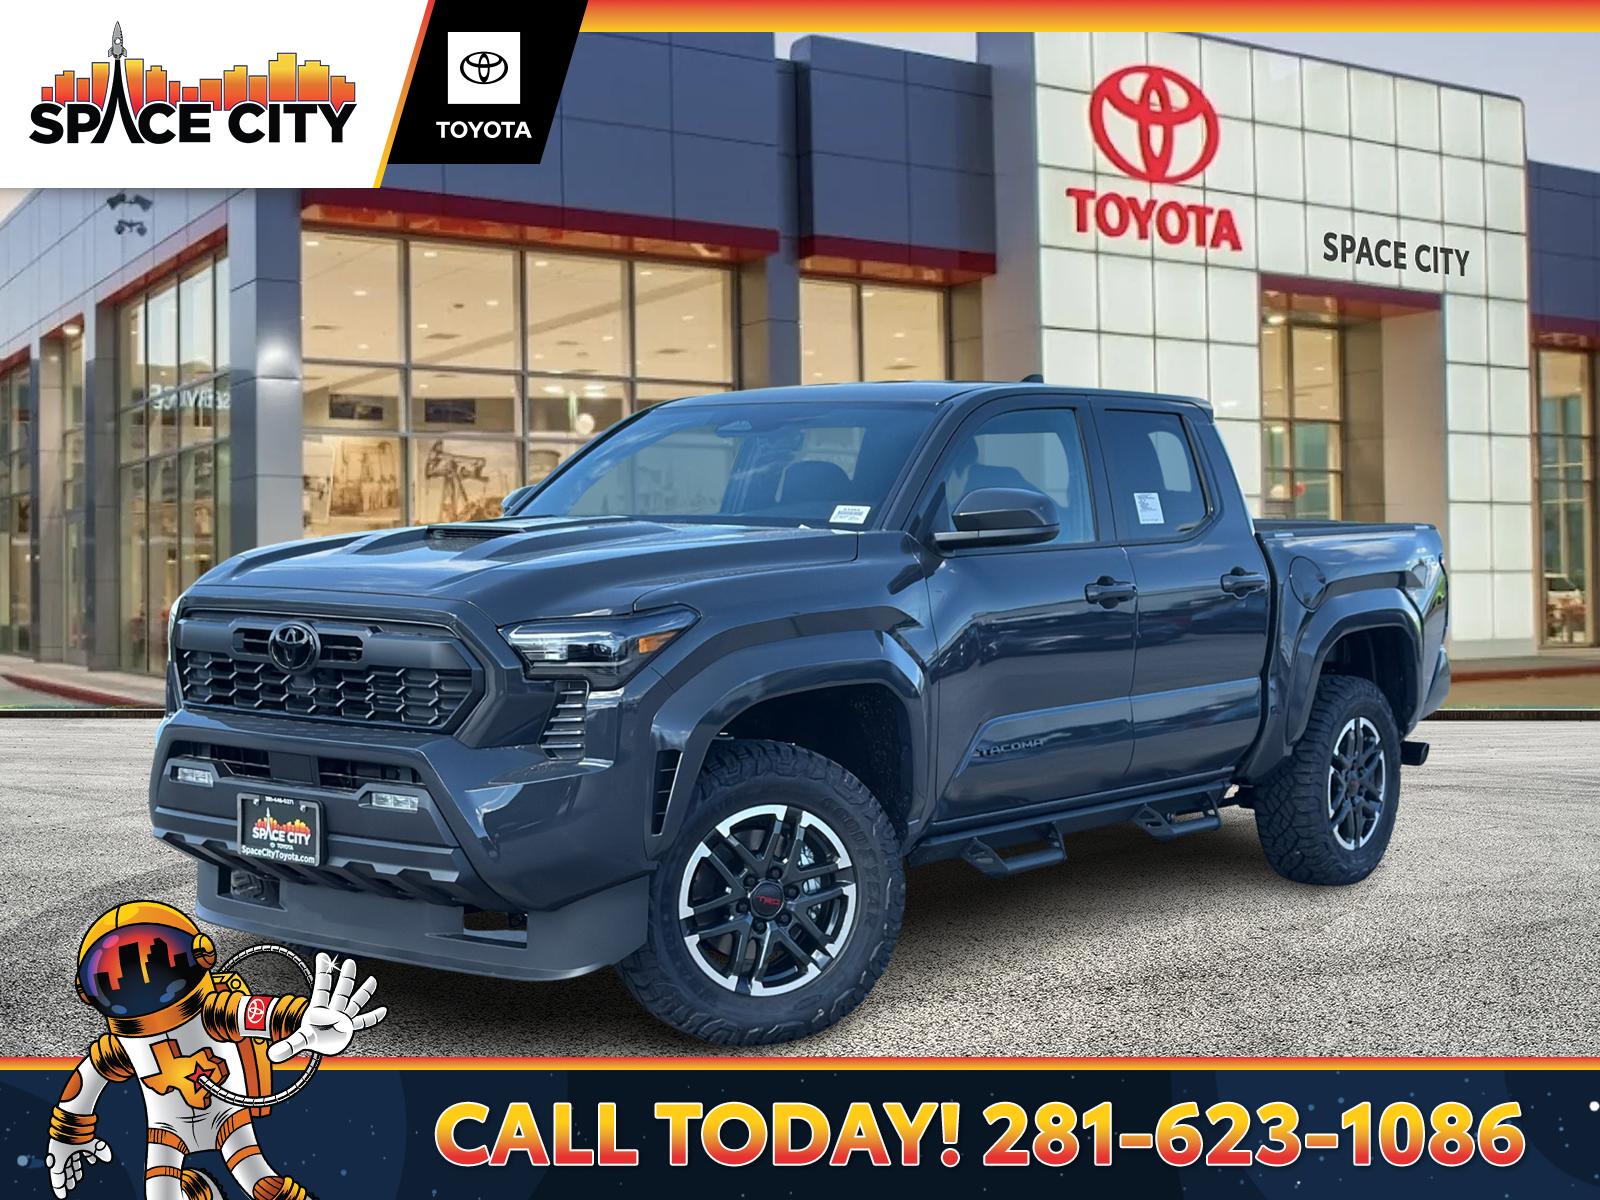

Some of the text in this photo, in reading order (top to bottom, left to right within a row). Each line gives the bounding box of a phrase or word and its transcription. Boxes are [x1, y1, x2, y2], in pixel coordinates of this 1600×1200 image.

[1065, 187, 1243, 252] TOYOTA
[1322, 231, 1471, 277] SPACE CITY
[980, 739, 1045, 757] TACOMA
[252, 825, 311, 845] SPACE CITY
[241, 845, 315, 864] SpaceCityToyota.com
